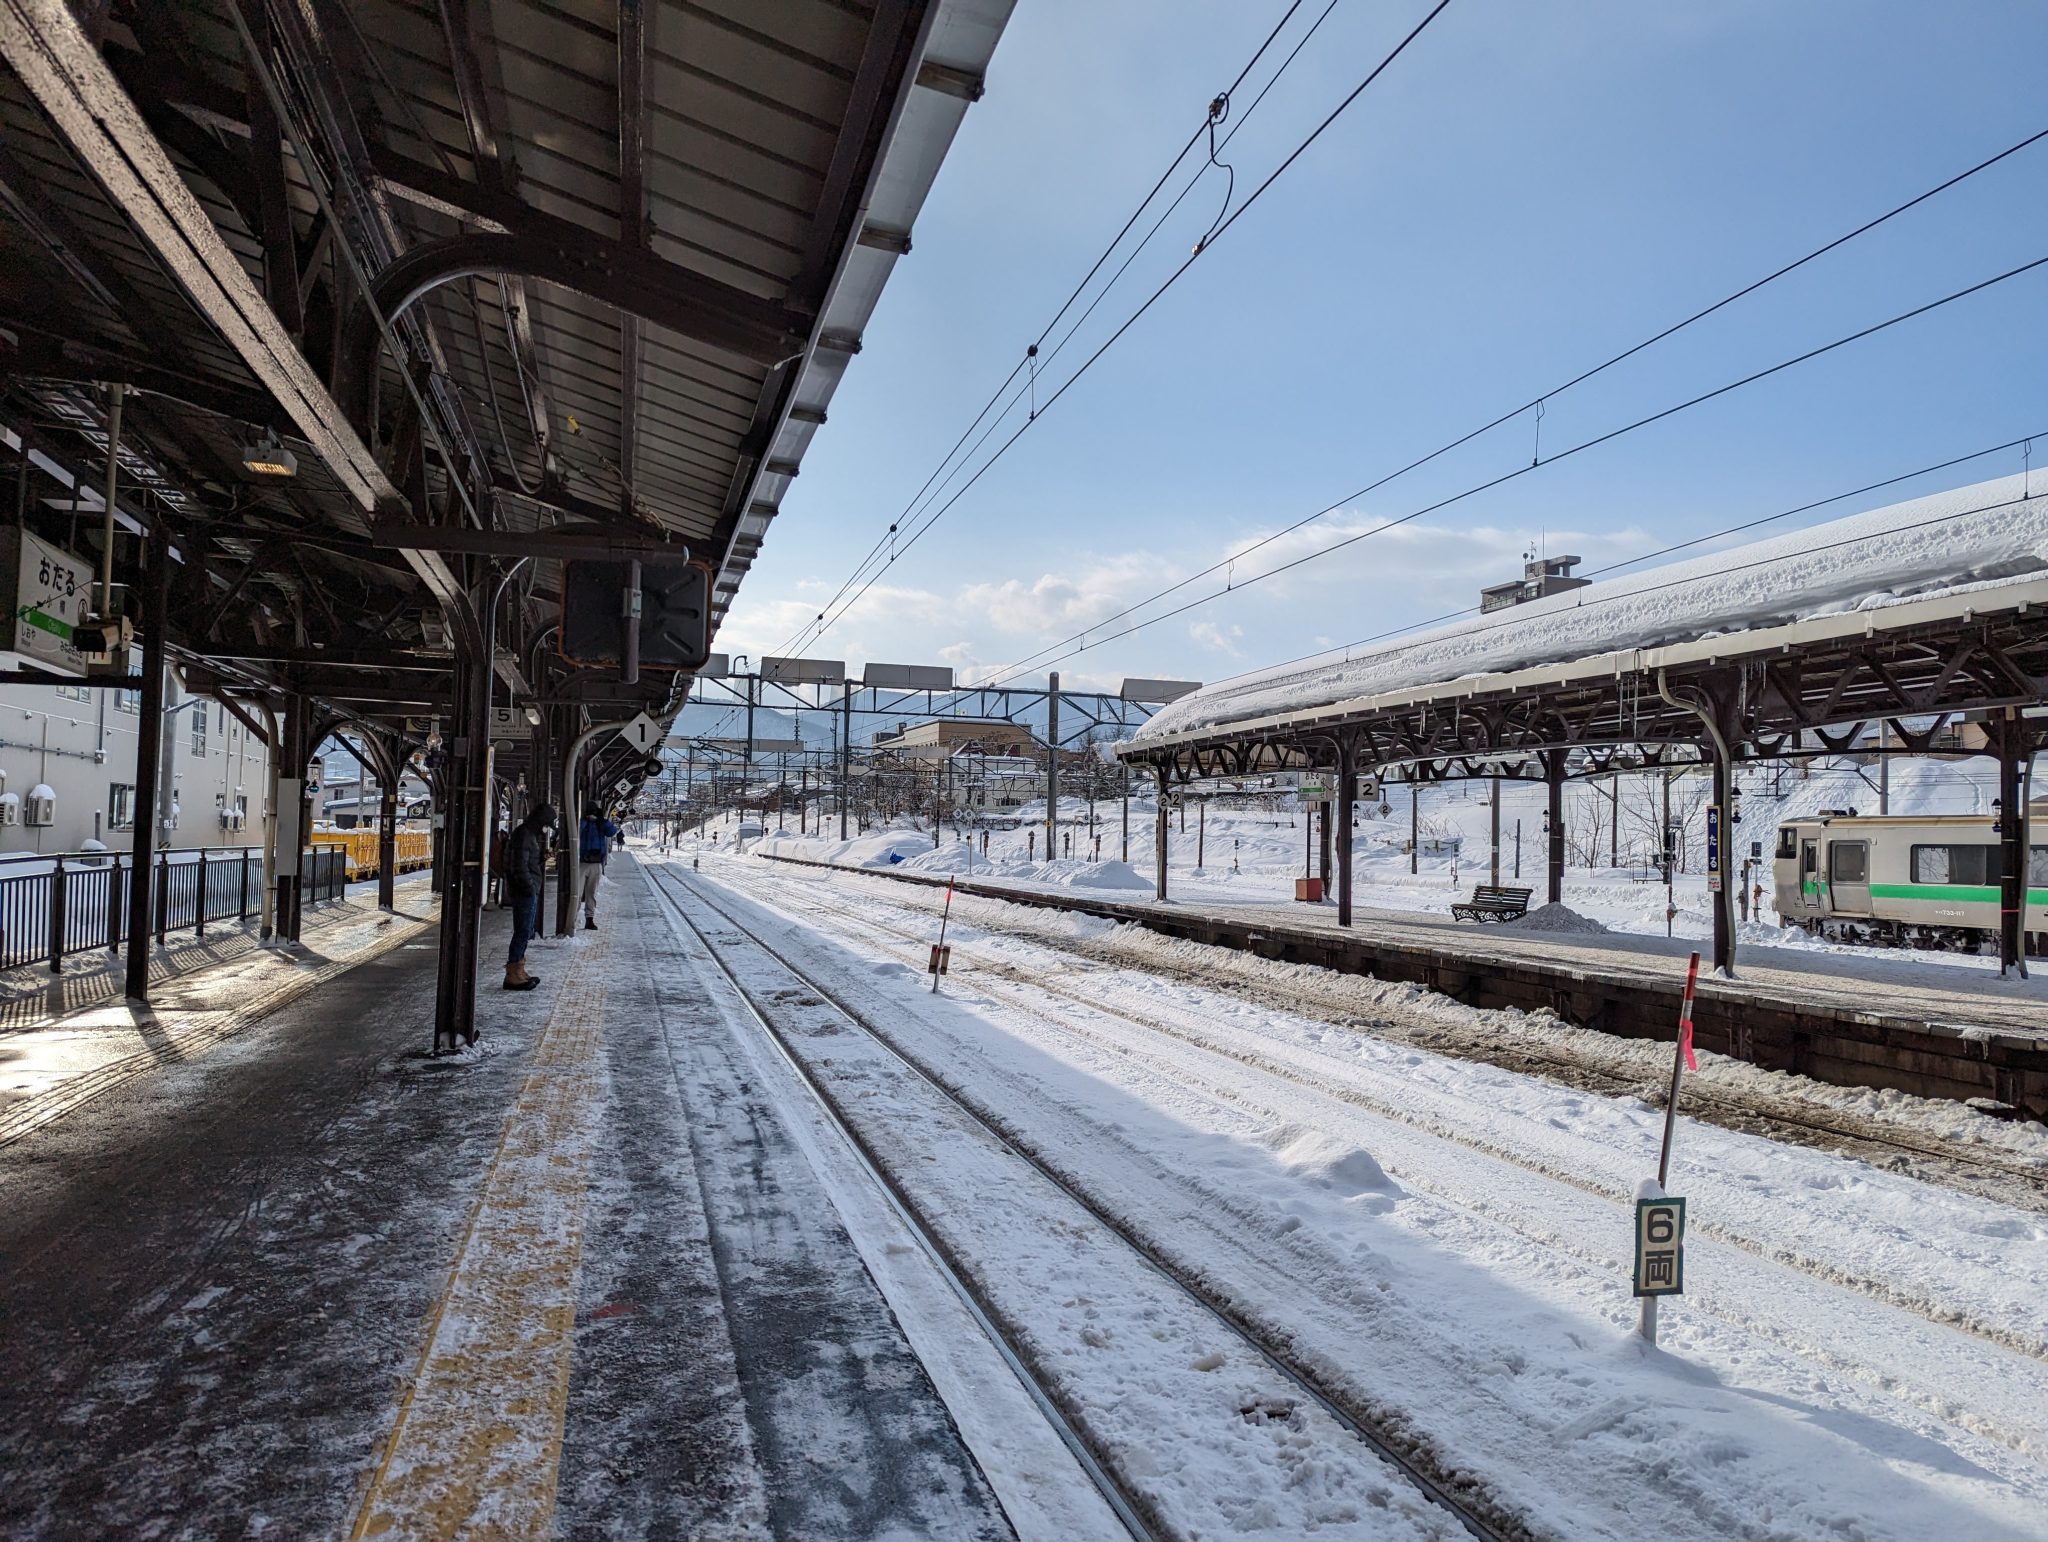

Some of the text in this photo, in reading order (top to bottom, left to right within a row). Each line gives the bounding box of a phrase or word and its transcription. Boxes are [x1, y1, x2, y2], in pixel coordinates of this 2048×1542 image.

[39, 556, 75, 597] おたる
[497, 709, 510, 722] 5
[638, 723, 646, 743] 1
[620, 782, 628, 791] 2
[1362, 783, 1374, 796] 2
[1160, 797, 1168, 807] 2
[1173, 794, 1180, 806] 2
[1382, 805, 1389, 814] 2
[1709, 813, 1717, 868] おたる
[1644, 1207, 1675, 1288] 6両
